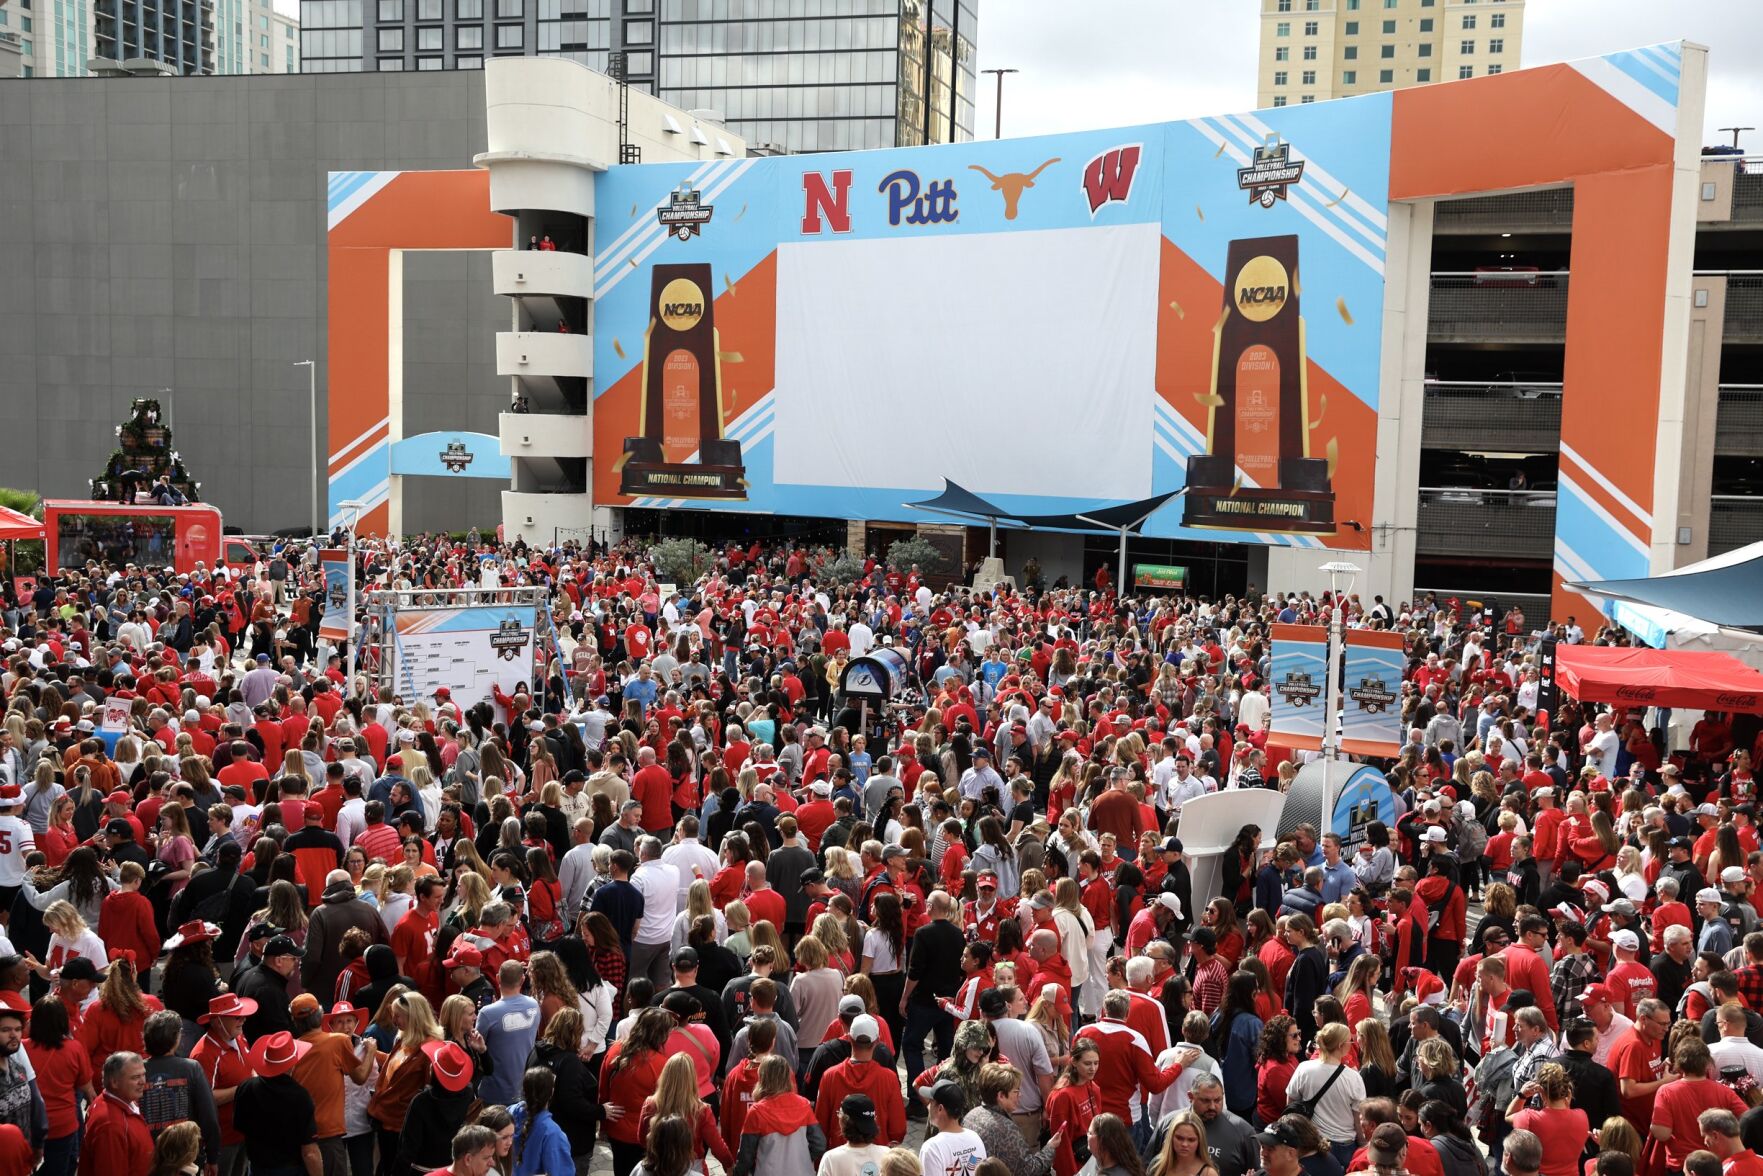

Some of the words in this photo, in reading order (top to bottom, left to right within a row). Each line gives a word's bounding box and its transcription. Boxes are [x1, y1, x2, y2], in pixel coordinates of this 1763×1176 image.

[1242, 168, 1300, 184] CHAMPIONSHIP
[801, 169, 853, 235] N
[878, 169, 960, 226] Pitt
[1080, 142, 1144, 221] W
[661, 211, 710, 220] CHAMPIONSHIP
[1239, 286, 1285, 304] NCAA
[663, 303, 702, 317] NCAA
[1241, 361, 1270, 370] DIVISION
[647, 473, 681, 484] NATIONAL
[682, 475, 721, 486] CHAMPION
[1215, 500, 1256, 514] NATIONAL
[1257, 502, 1304, 517] CHAMPION
[1279, 686, 1318, 695] CHAMPIONSHIP
[1353, 692, 1394, 702] CHAMPIONSHIP
[1615, 686, 1656, 699] Coca-Cola
[1716, 693, 1757, 707] Coca-Cola
[952, 1146, 977, 1157] VOLCOM
